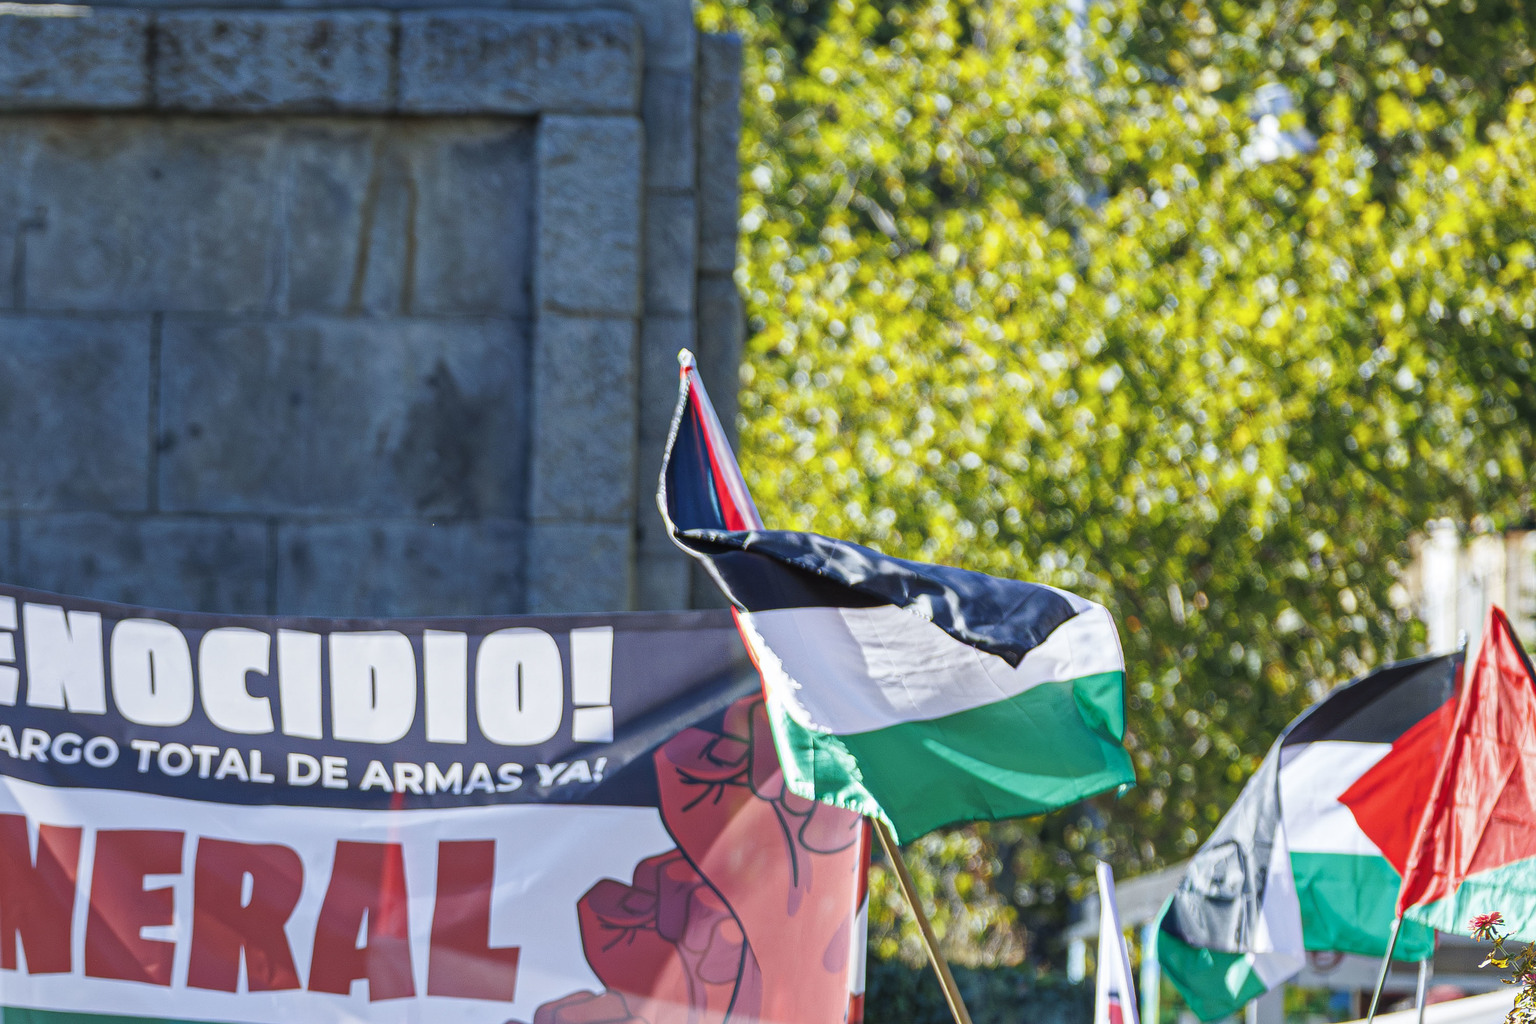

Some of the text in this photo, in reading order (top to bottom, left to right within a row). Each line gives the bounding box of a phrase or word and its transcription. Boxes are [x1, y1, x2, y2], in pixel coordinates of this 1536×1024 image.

[132, 739, 277, 785] TOTAL
[286, 756, 349, 790] DE
[359, 759, 524, 796] ARMAS
[536, 755, 609, 787] YA!
